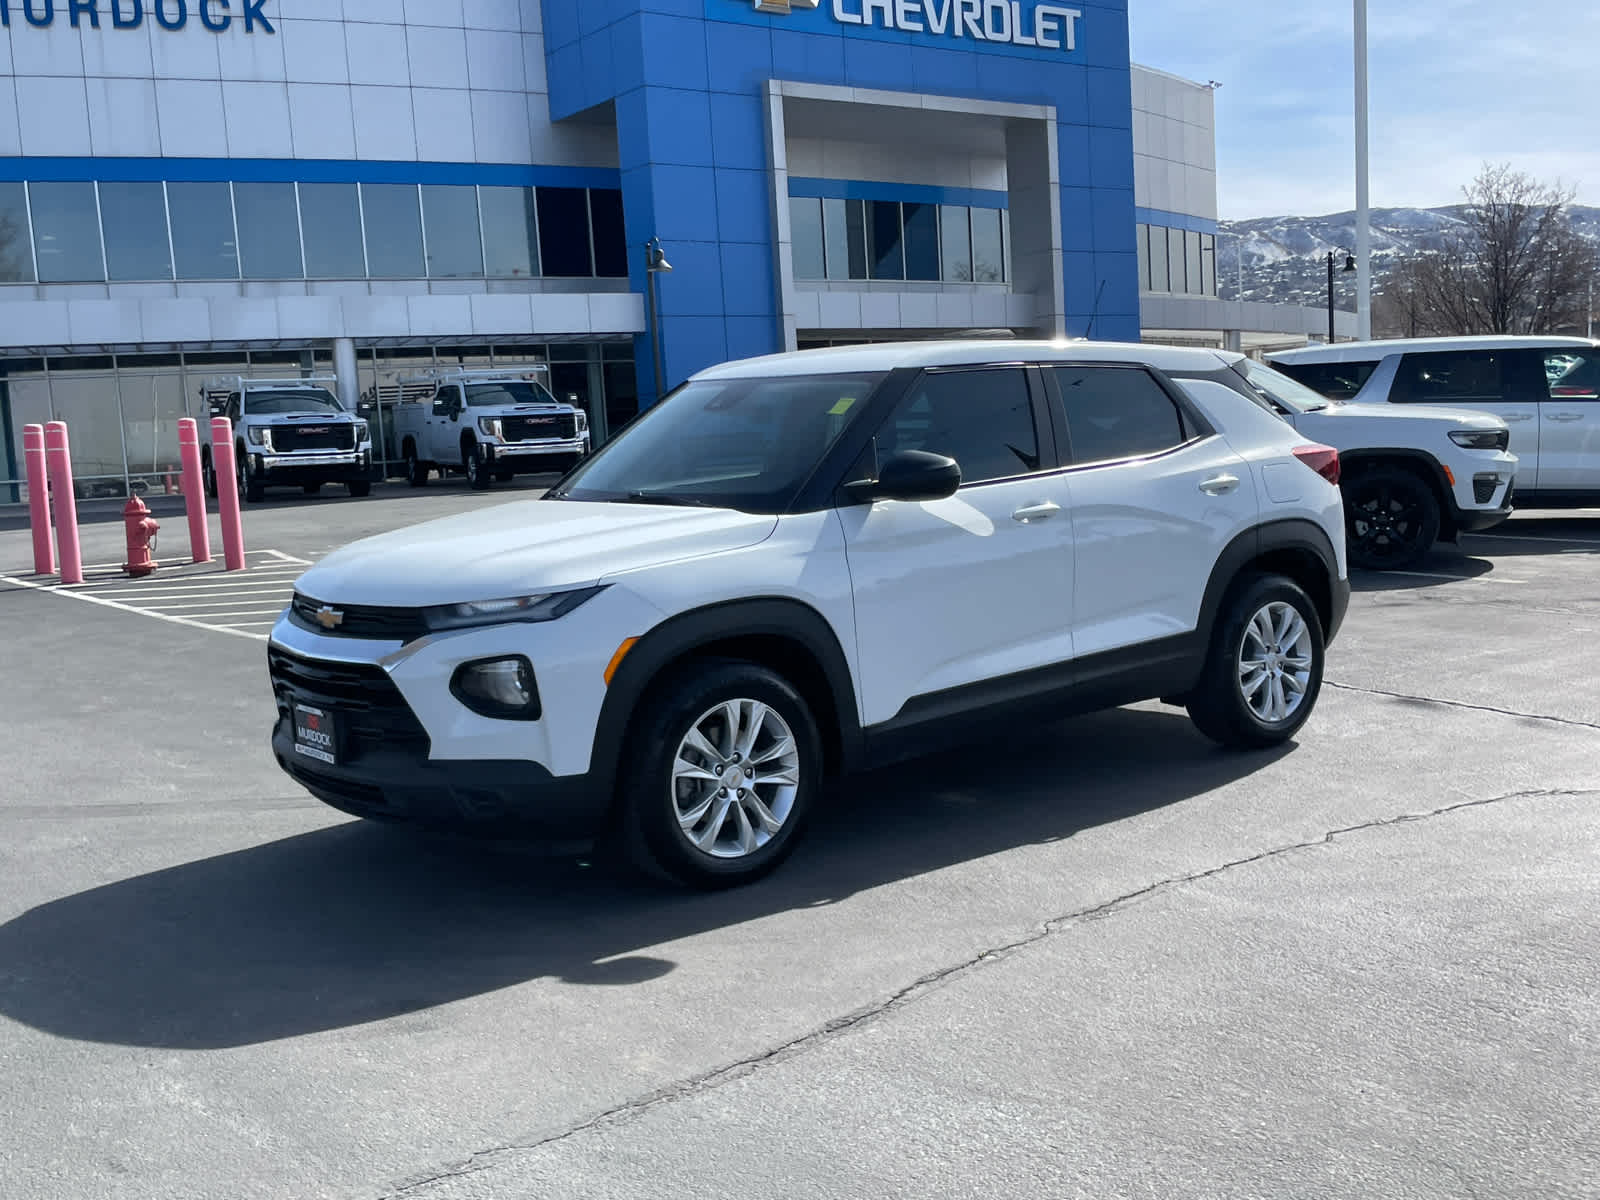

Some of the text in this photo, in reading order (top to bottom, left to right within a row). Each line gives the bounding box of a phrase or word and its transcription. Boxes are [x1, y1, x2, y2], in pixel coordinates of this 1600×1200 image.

[0, 0, 275, 34] URDOCK
[832, 0, 1081, 50] CHEVROLET
[298, 426, 328, 434] GMC
[525, 417, 555, 425] GMC
[298, 727, 330, 746] MURDOCK
